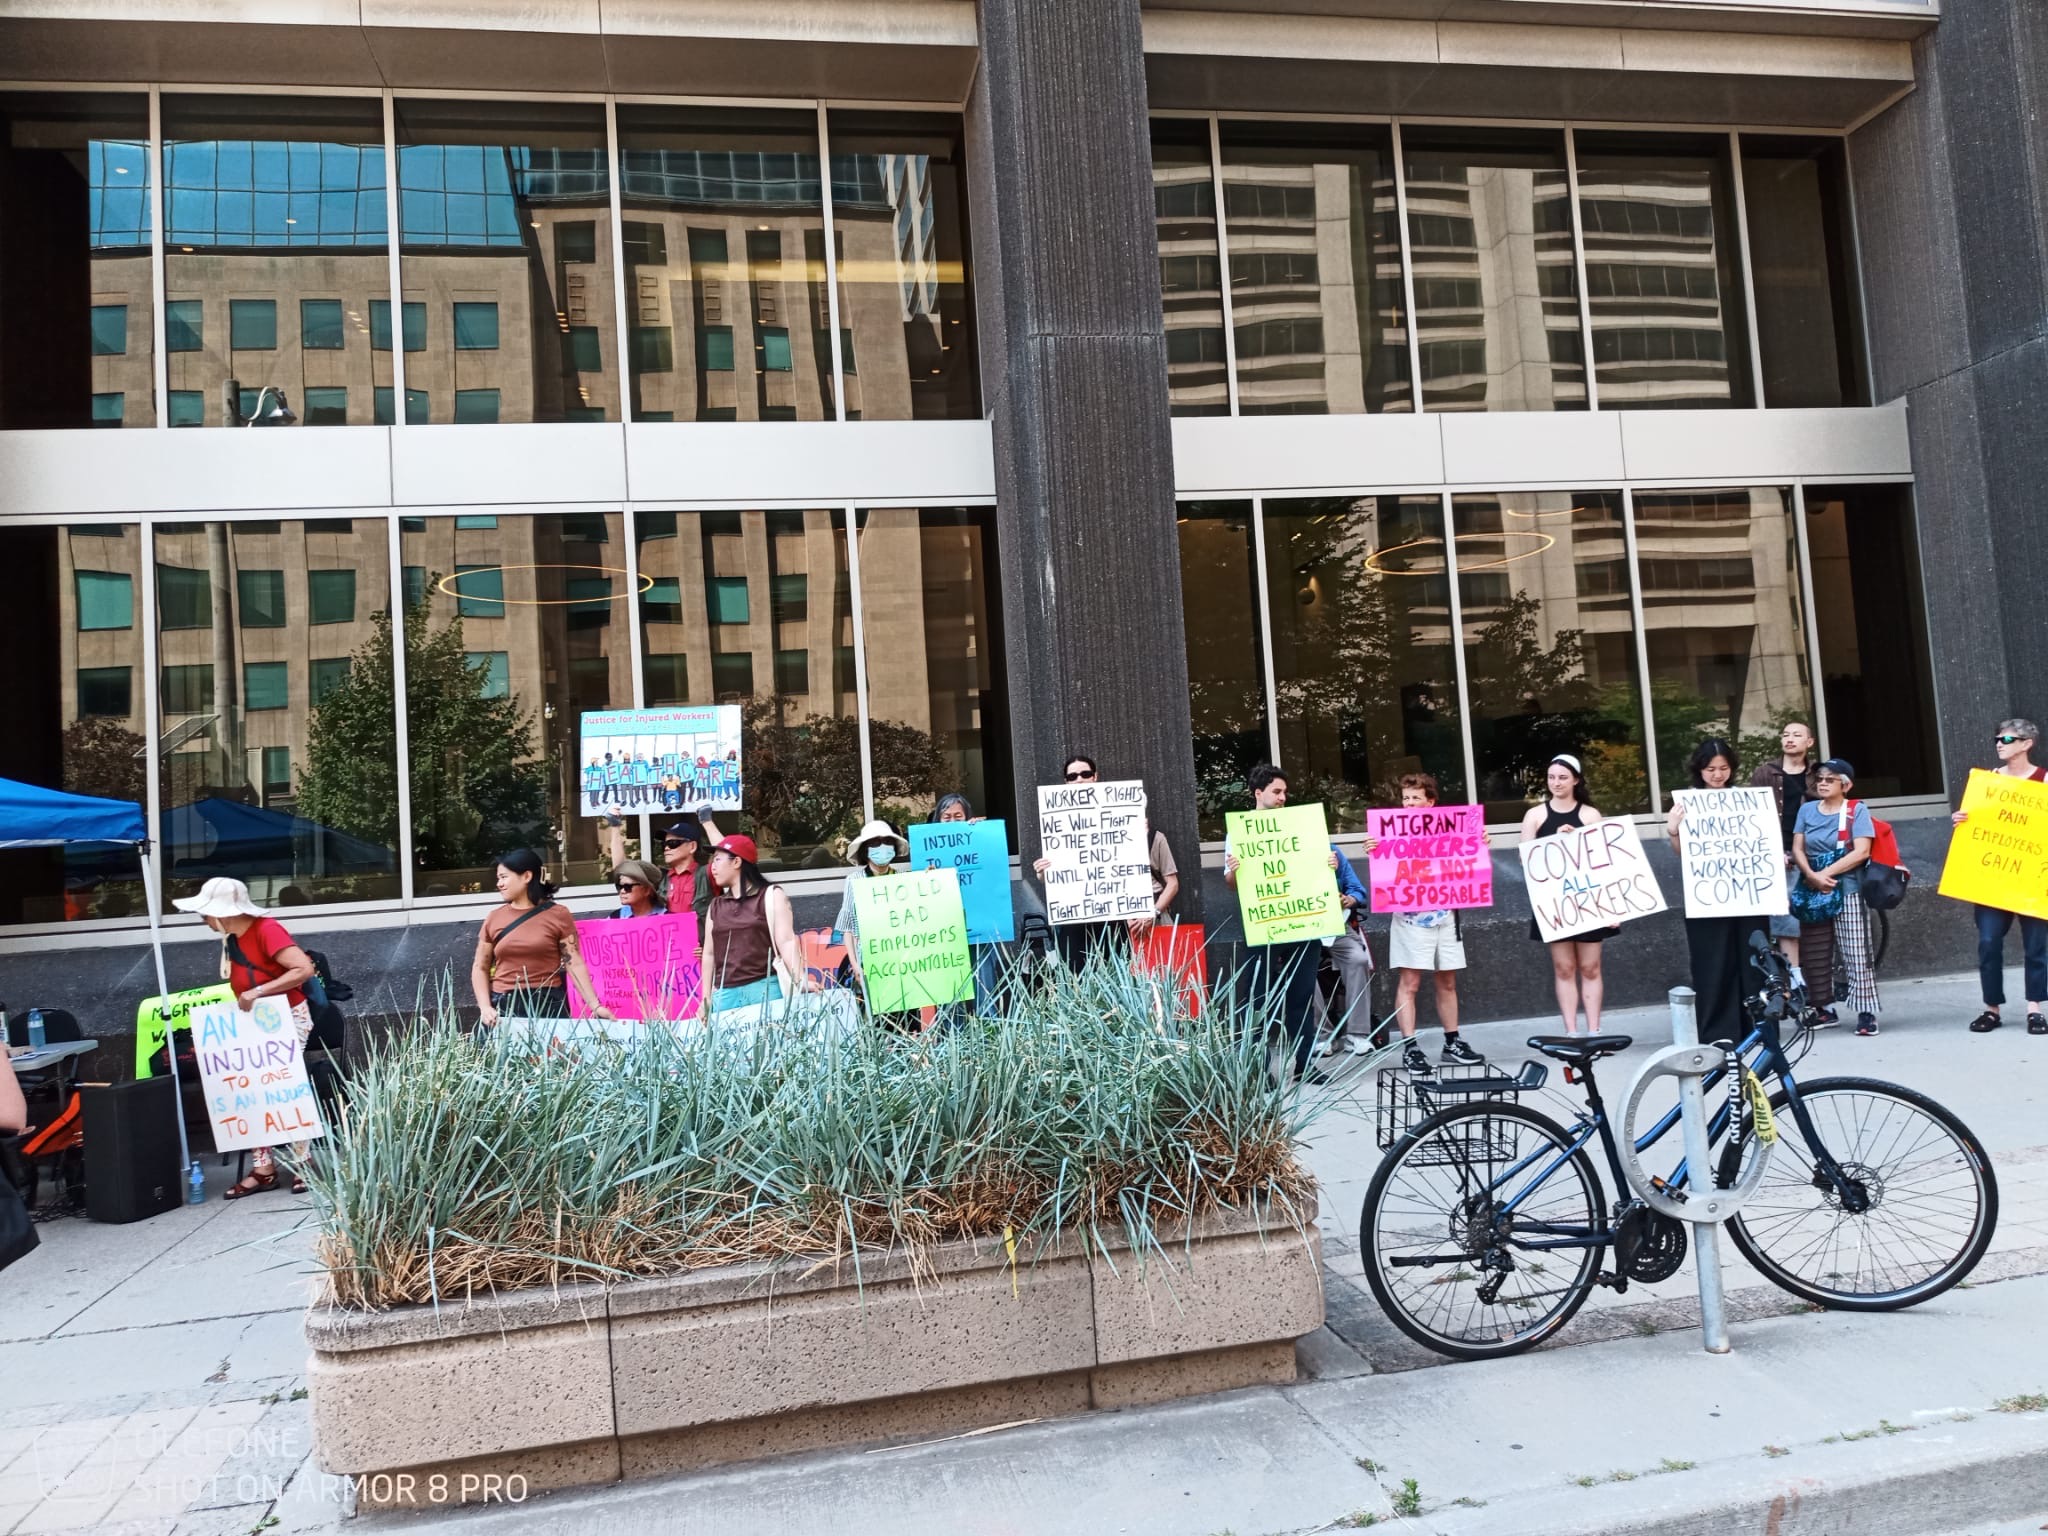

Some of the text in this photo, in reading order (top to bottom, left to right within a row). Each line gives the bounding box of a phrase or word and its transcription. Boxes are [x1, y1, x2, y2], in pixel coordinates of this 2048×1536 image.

[584, 711, 714, 725] Justice for Injured Workers!
[1044, 786, 1144, 809] WORKER RIGHTS
[1682, 791, 1769, 814] MIGRANT
[1985, 786, 2048, 813] WORKER
[1042, 811, 1138, 834] WE WILL FIGHT
[1380, 811, 1467, 837] MIGRANT
[1685, 814, 1763, 840] WORKERS
[1998, 808, 2028, 826] PAIN
[924, 831, 974, 849] INJURY
[1043, 830, 1133, 851] TO THE BITTER
[1236, 836, 1301, 859] JUSTICE
[1370, 835, 1479, 860] WORKERS
[1689, 837, 1770, 857] DESERVE
[1972, 826, 2043, 856] EMPLOYERS
[926, 853, 979, 869] TO ONE
[1079, 846, 1119, 864] END!
[1527, 823, 1637, 882] COVER
[1981, 852, 2022, 874] GAIN
[1046, 864, 1151, 885] UNTIL WE SEE THE
[1263, 859, 1286, 876] NO
[1394, 857, 1478, 886] ARE NOT
[1690, 853, 1775, 879] WORKERS
[872, 879, 943, 904] HOLD
[1084, 878, 1128, 897] LIGHT!
[1255, 881, 1291, 898] HALF
[1562, 873, 1601, 895] ALL
[1694, 877, 1774, 906] COMP
[1374, 882, 1490, 911] DISPOSABLE
[1537, 873, 1658, 931] WORKERS
[888, 906, 930, 928] BAD
[202, 1011, 239, 1048] AN
[203, 1039, 296, 1076] INJURY
[223, 1067, 293, 1092] TO ONE
[212, 1098, 227, 1114] IS
[235, 1093, 258, 1112] AN
[218, 1116, 249, 1138] TO
